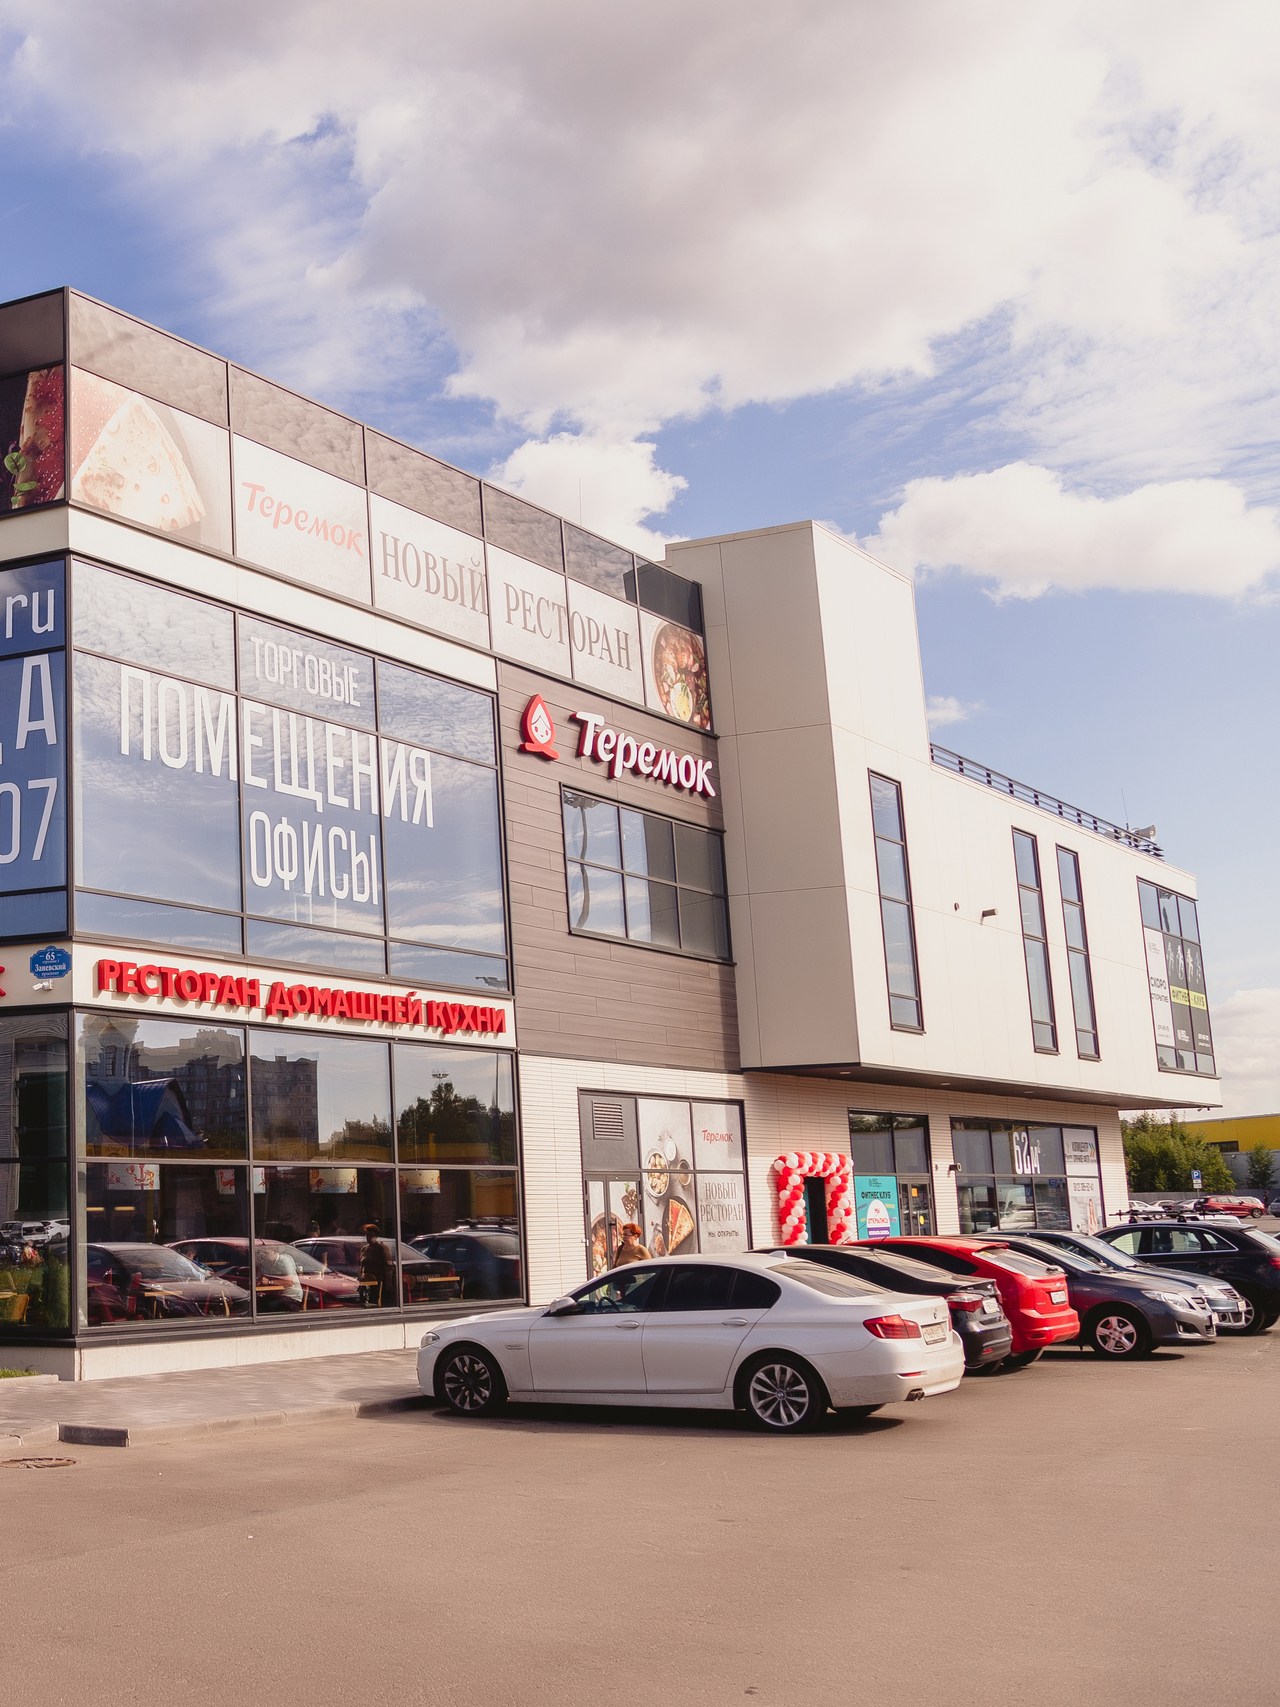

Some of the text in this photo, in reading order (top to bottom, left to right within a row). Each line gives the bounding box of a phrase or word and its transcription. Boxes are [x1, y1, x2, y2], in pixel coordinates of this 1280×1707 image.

[240, 480, 365, 557] Теремок
[380, 531, 634, 673] НОВЫЙ РЕСТОРАН
[250, 636, 361, 707] ТОРГОВЫЕ
[121, 665, 434, 828] ПОМЕЩЕНИЯ
[570, 711, 716, 798] Теремок
[249, 811, 379, 905] ОФИСЫ
[45, 952, 55, 960] 65
[97, 958, 507, 1034] РЕСТОРАН ДОМАШНЕЙ КУХНИ
[702, 1129, 733, 1144] Теремок
[700, 1203, 744, 1222] РЕСТОРАН
[705, 1179, 736, 1199] НОВЫЙ
